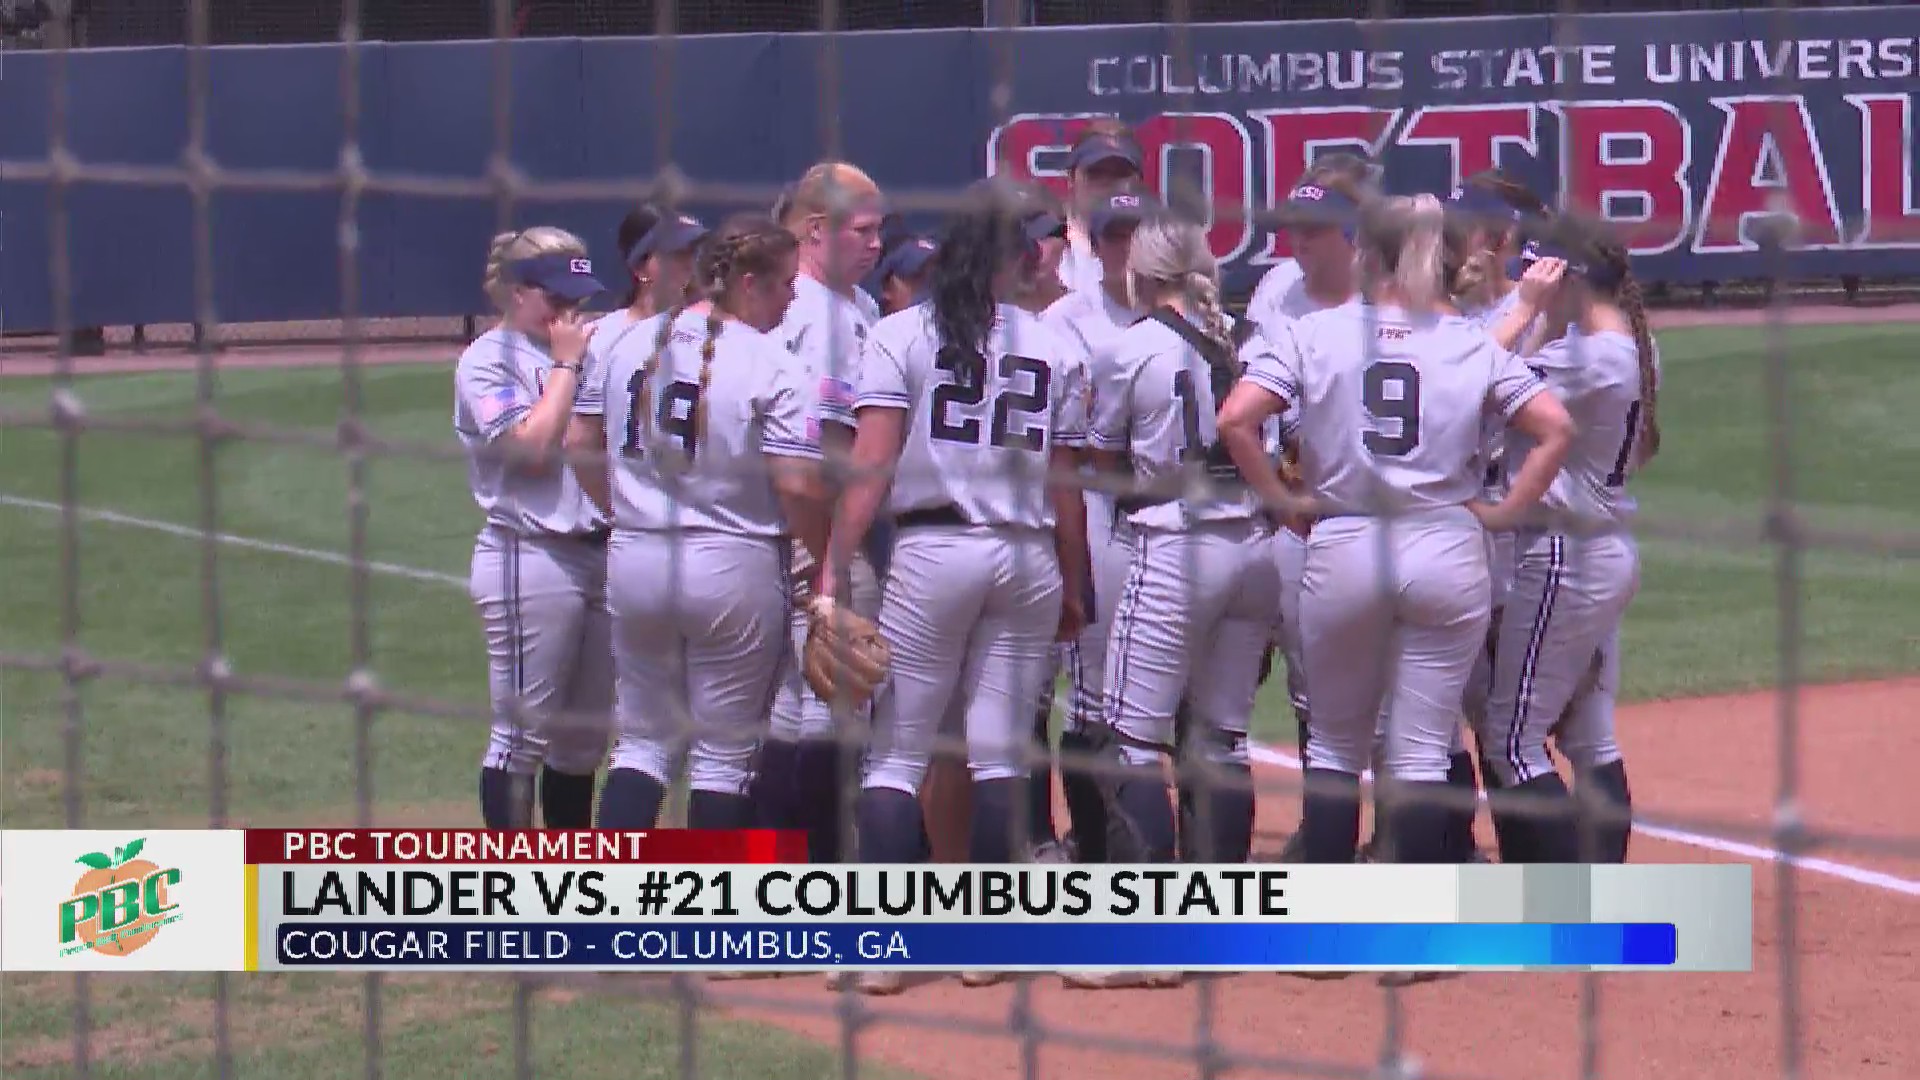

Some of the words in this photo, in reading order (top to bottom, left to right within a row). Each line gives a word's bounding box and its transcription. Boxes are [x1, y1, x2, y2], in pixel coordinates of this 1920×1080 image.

[1088, 50, 1403, 95] COLUMBUS
[1431, 45, 1616, 89] STATE
[1645, 37, 1920, 83] UNIVERS
[930, 350, 1051, 452] 22
[1361, 361, 1422, 458] 9
